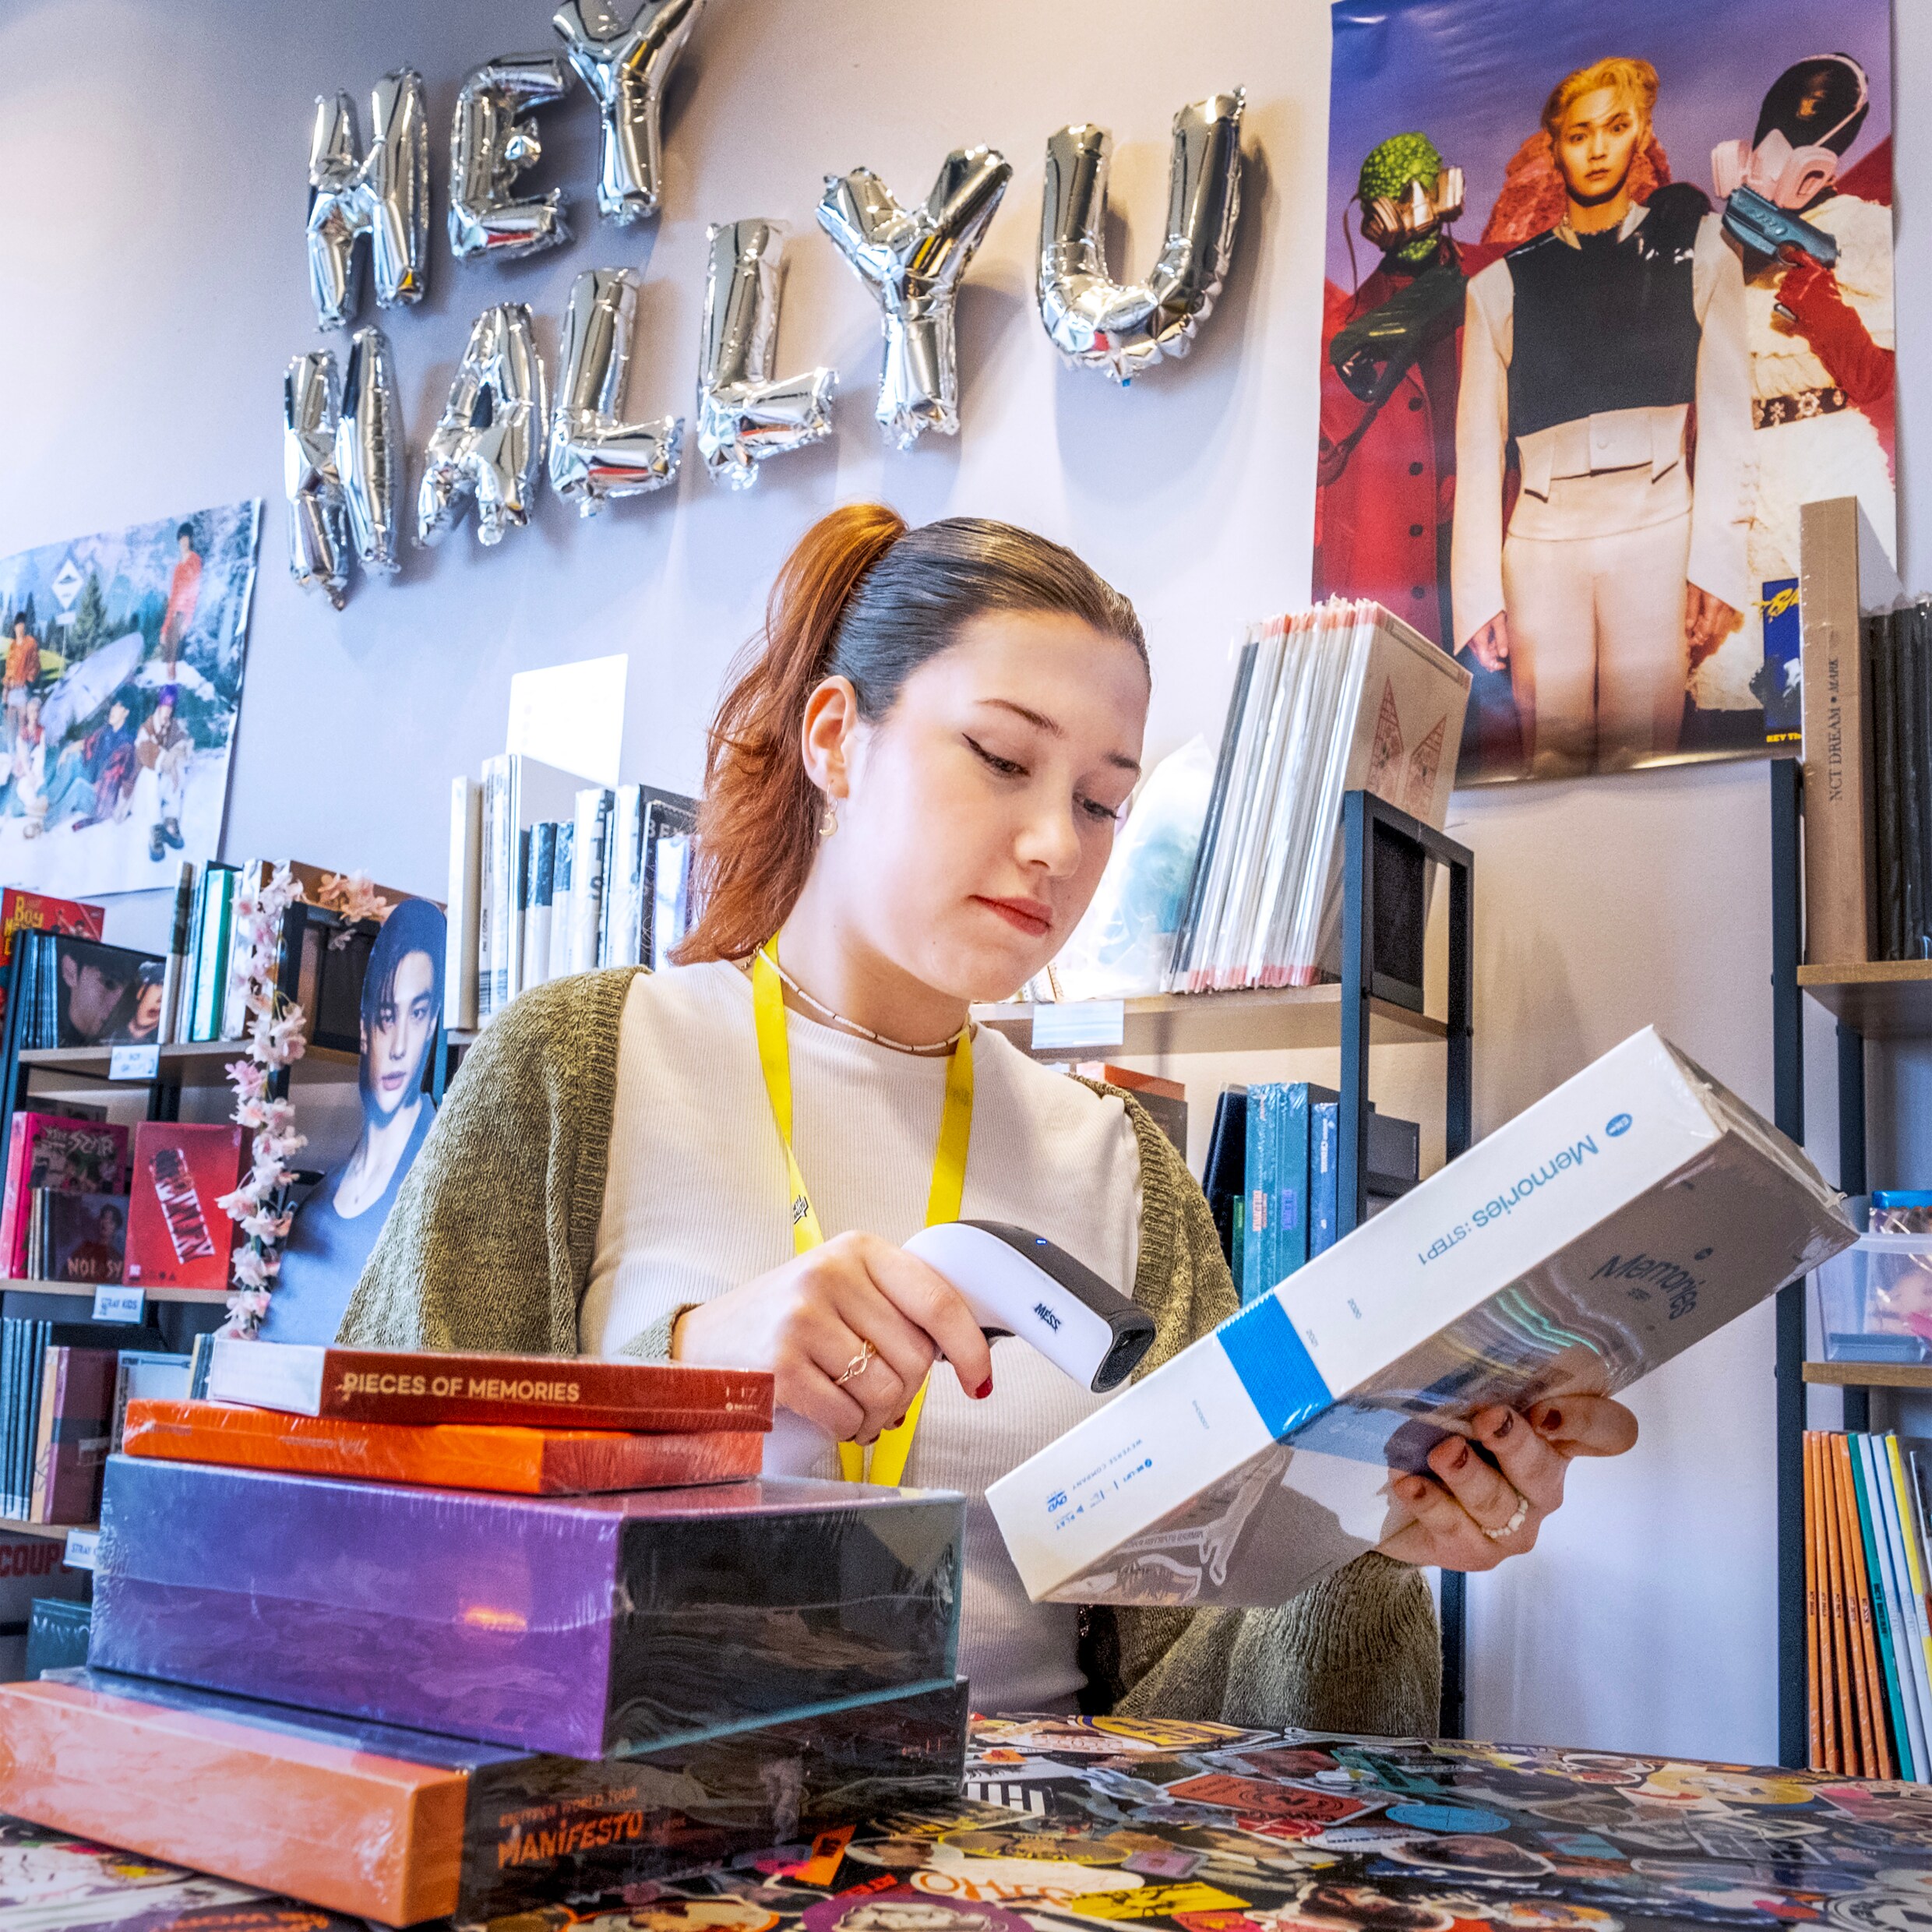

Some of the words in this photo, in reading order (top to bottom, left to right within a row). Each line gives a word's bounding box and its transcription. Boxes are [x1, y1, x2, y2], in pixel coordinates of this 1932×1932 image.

[304, 0, 706, 333] HEY
[284, 84, 1248, 610] HALLYU
[1828, 658, 1839, 693] MARK
[1829, 707, 1842, 765] DREAM
[1829, 770, 1842, 802] NCT
[1469, 1134, 1600, 1229] Memories
[1591, 1253, 1704, 1319] Memories
[343, 1372, 426, 1400] PIECES
[435, 1375, 462, 1398] OF
[467, 1377, 580, 1403] MEMORIES
[1109, 1439, 1143, 1465] WEVERSE
[1072, 1464, 1108, 1490] COMPANY
[0, 1542, 73, 1577] COUP
